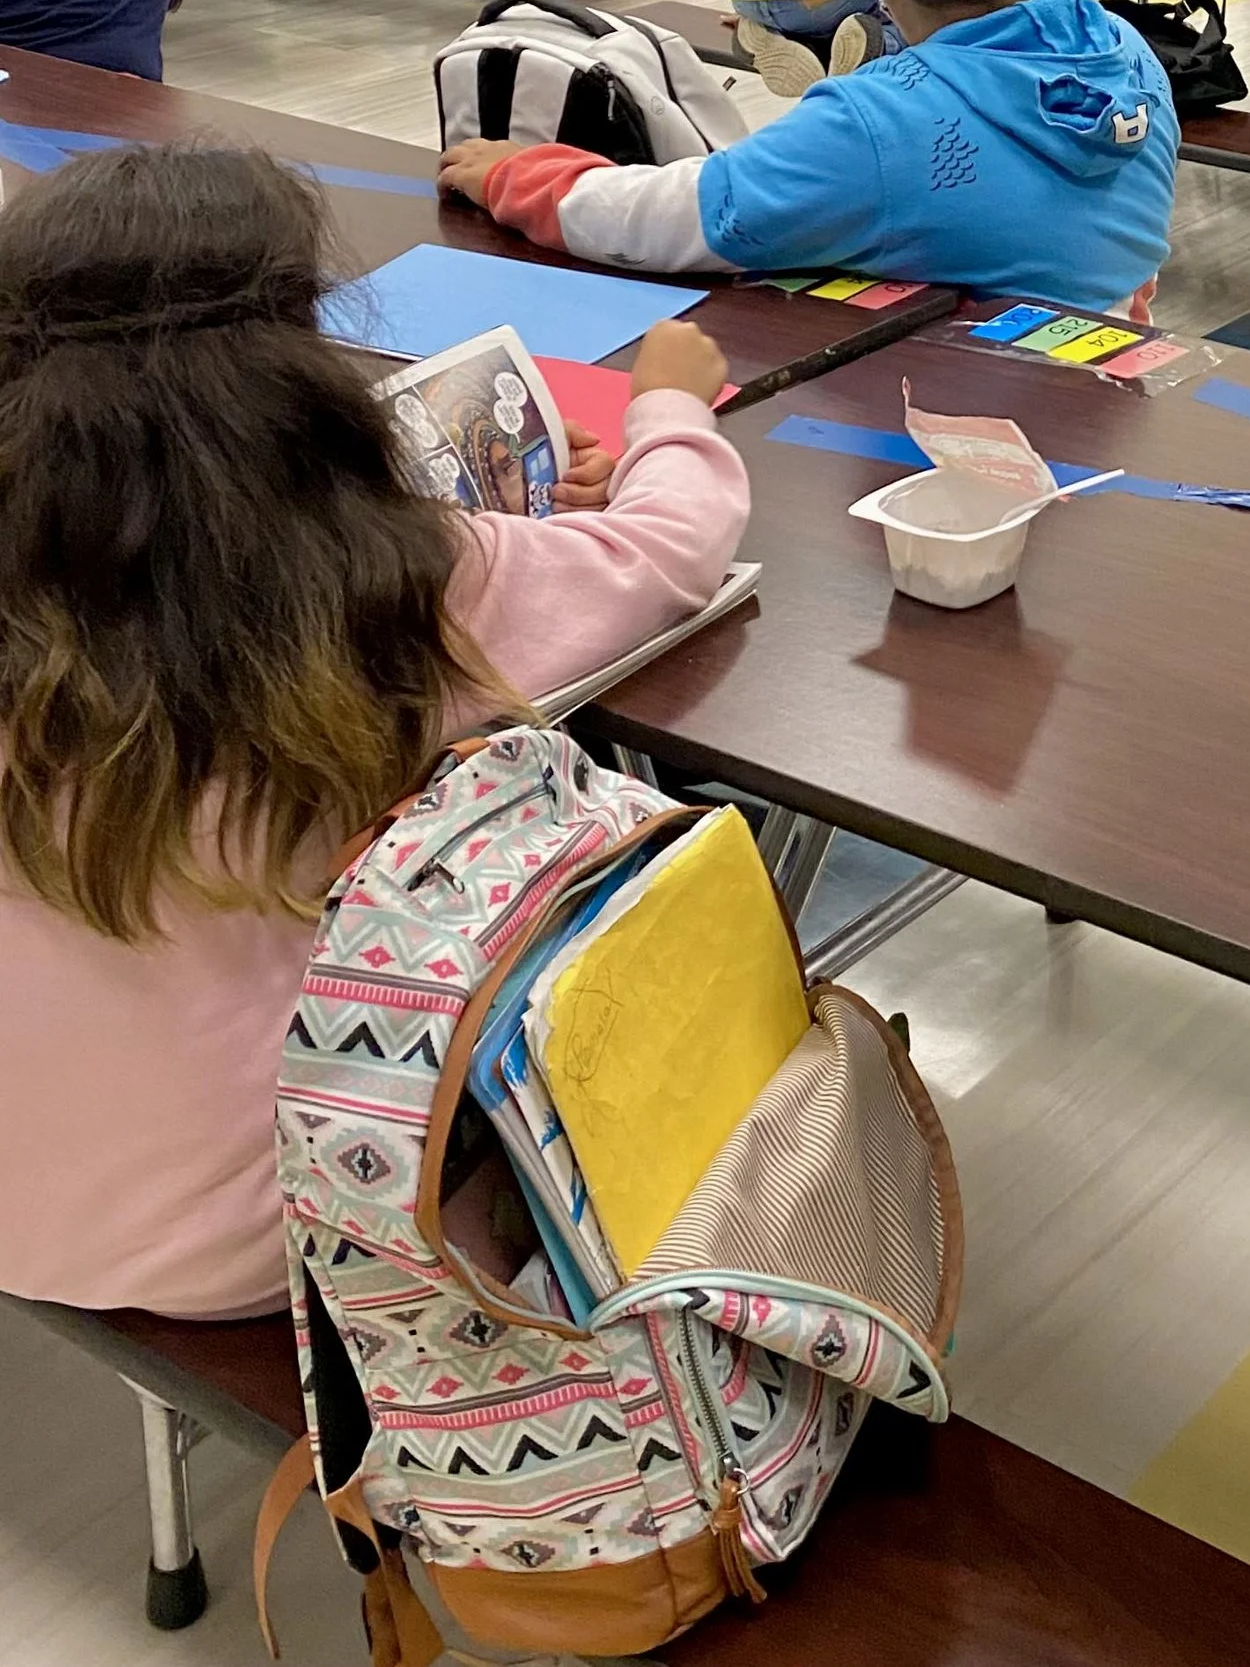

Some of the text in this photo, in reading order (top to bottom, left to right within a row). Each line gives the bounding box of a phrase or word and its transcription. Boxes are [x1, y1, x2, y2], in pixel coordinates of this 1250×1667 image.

[1048, 317, 1089, 337] 215
[1088, 329, 1129, 348] 104
[1136, 341, 1177, 361] 110
